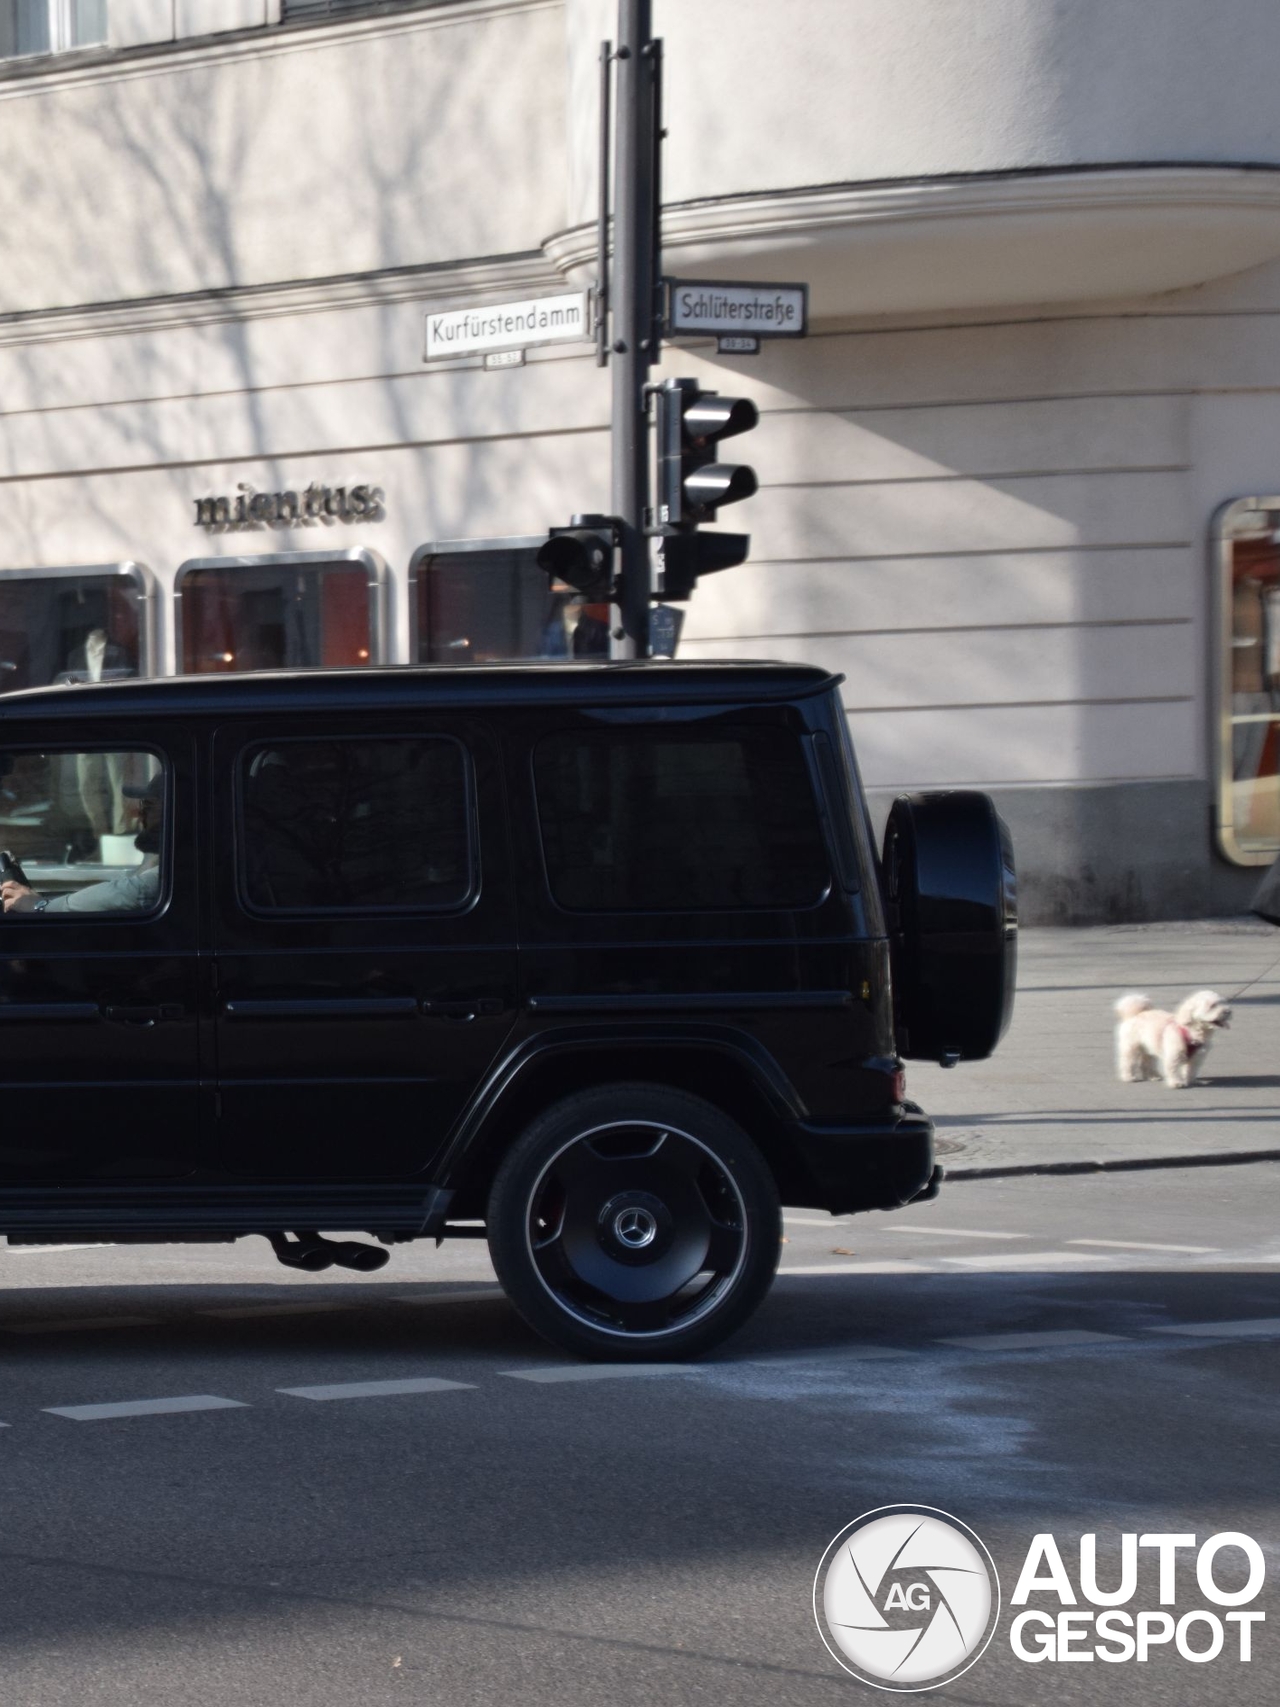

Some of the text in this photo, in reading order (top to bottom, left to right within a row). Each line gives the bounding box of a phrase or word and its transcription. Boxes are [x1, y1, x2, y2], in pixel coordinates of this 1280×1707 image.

[433, 306, 580, 343] Kurfürstendamm
[682, 293, 795, 325] Schlüterstraße
[194, 482, 376, 526] mientus
